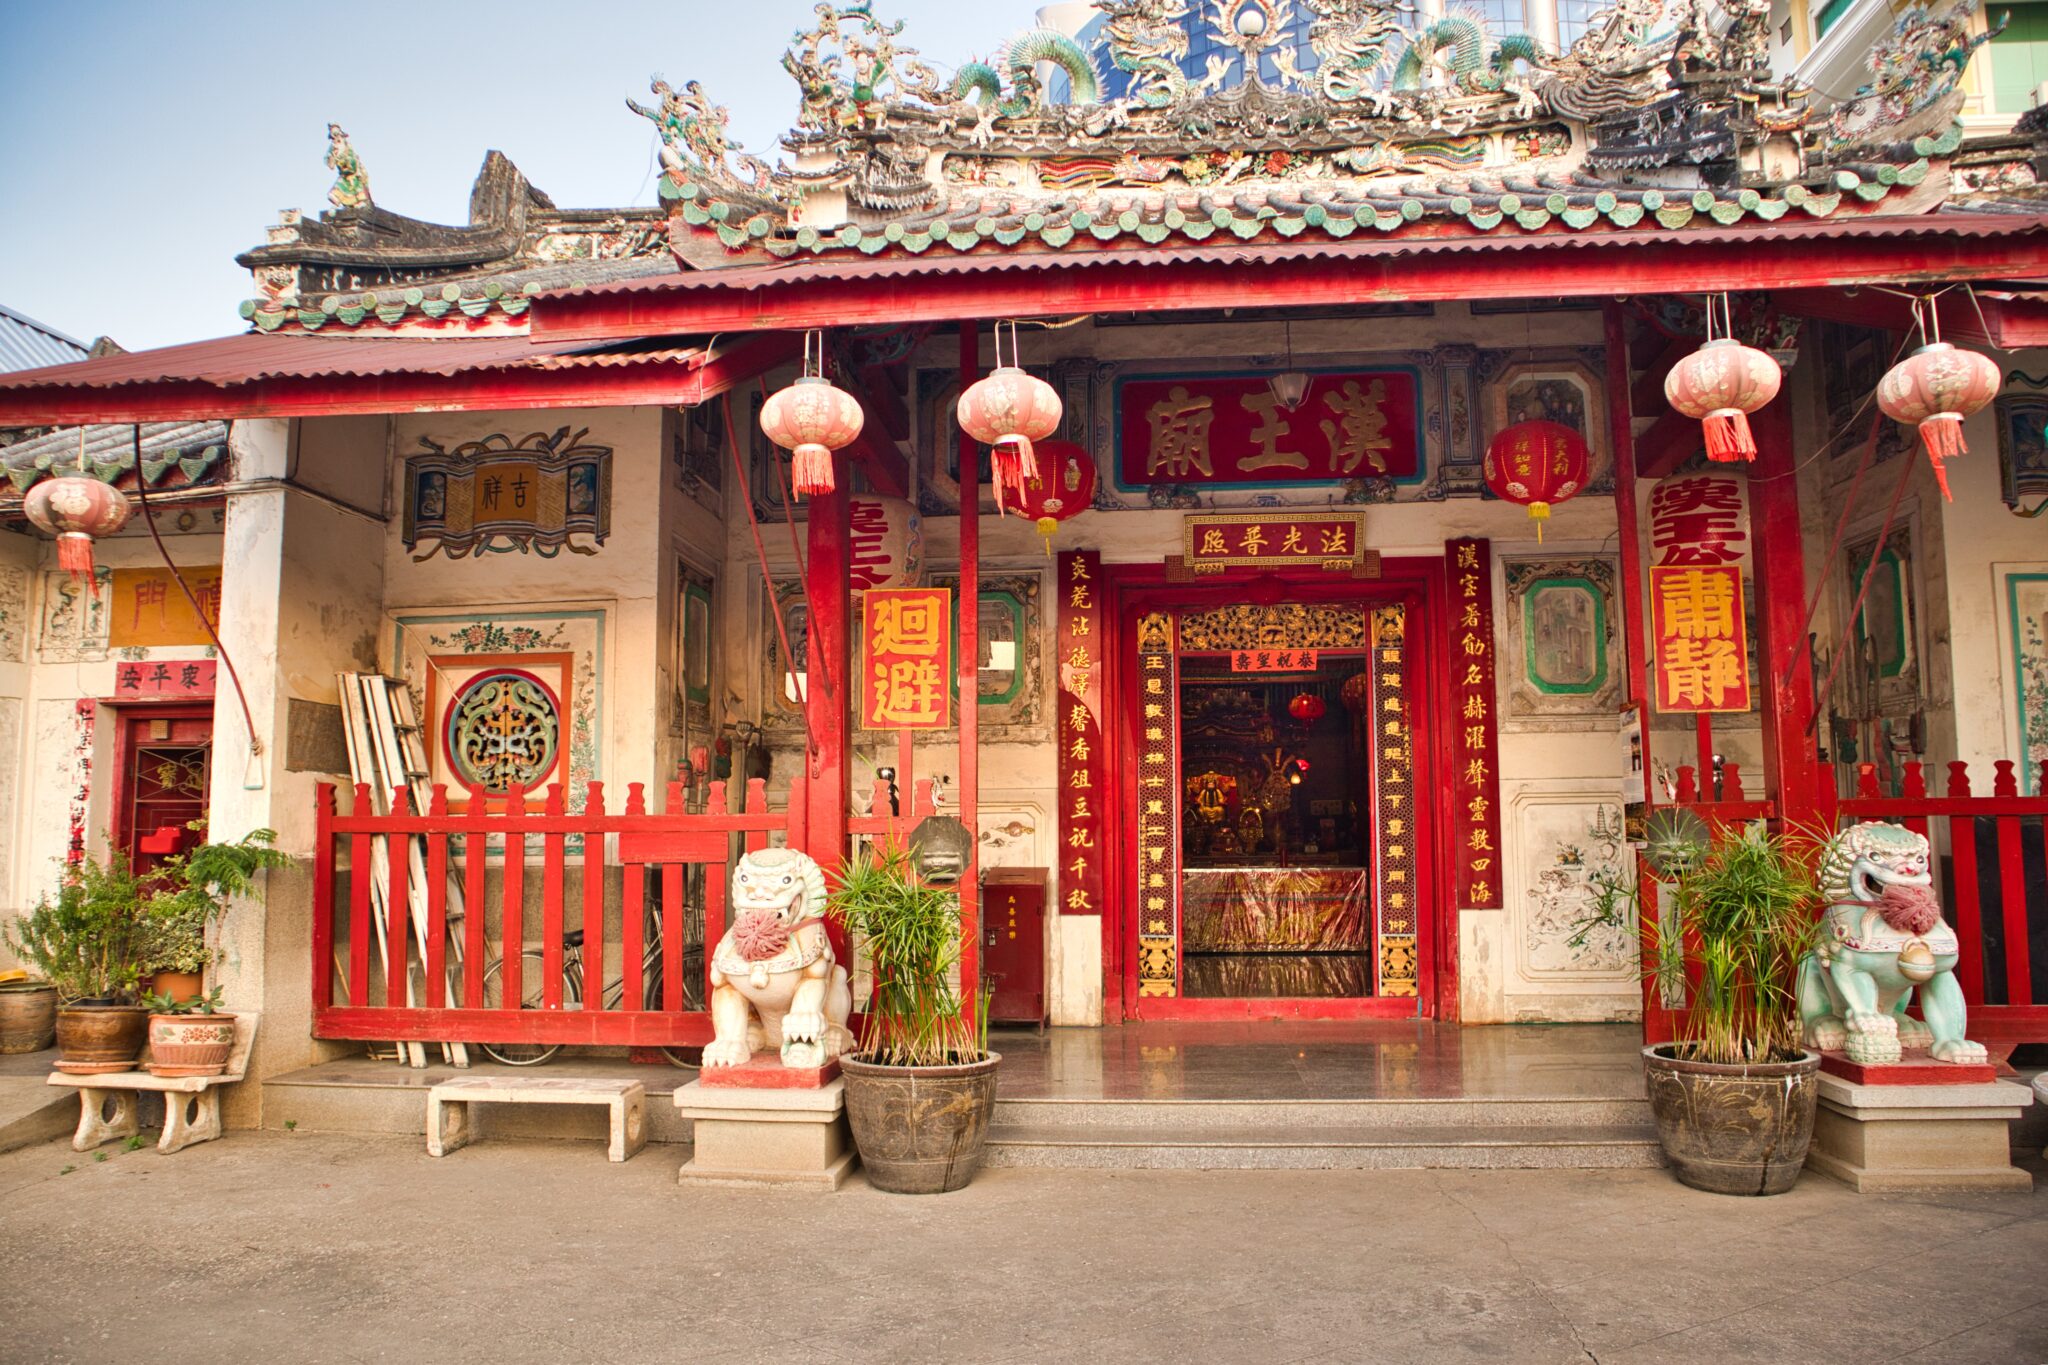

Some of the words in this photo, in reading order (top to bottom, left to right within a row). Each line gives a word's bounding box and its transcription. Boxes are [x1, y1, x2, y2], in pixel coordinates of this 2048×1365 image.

[1145, 377, 1393, 477] 漢王廟
[480, 472, 530, 512] 吉祥
[1199, 525, 1348, 556] 法光普照
[120, 662, 216, 690] 衆平安
